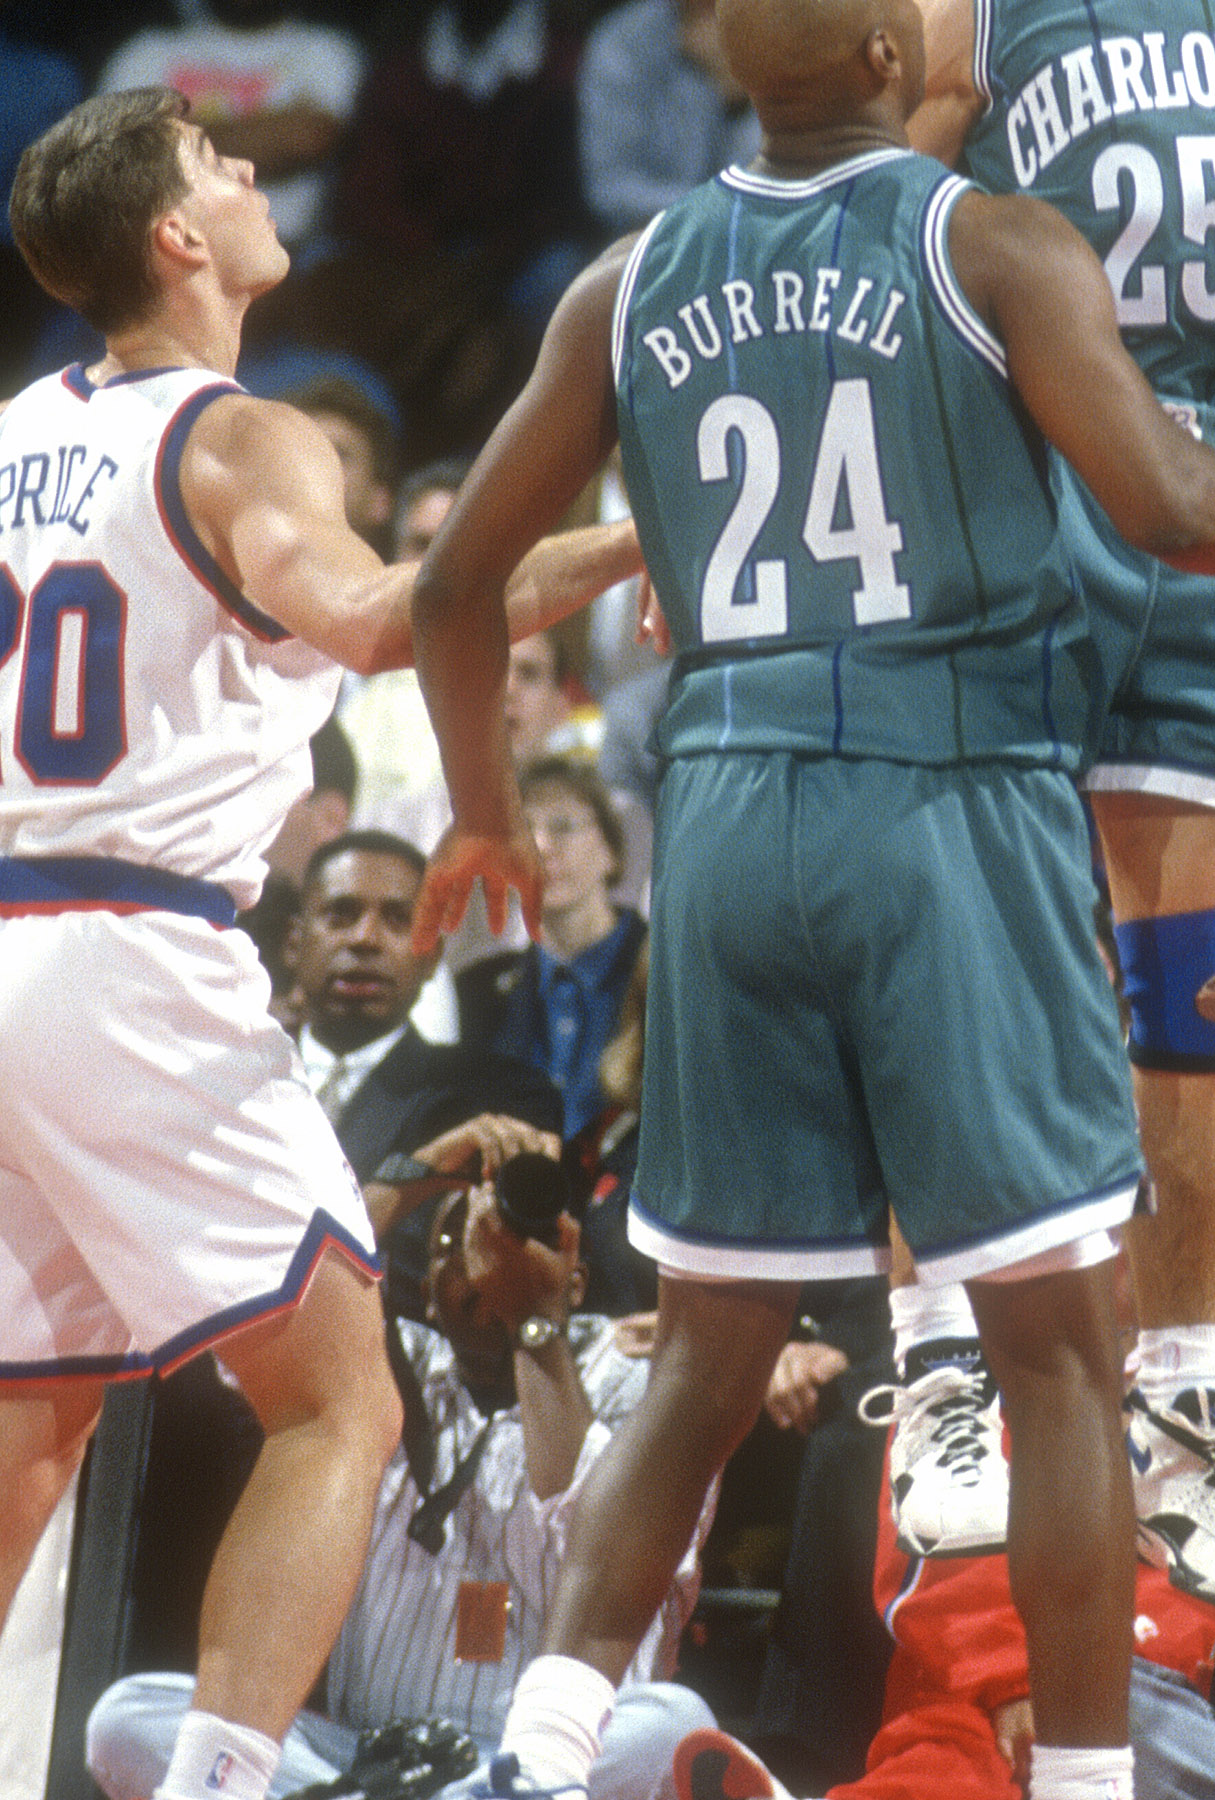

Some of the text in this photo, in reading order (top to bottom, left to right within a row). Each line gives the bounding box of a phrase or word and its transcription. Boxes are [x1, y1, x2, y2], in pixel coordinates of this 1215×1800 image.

[643, 267, 905, 388] BURRELL
[697, 378, 912, 642] 24
[0, 560, 128, 787] 0
